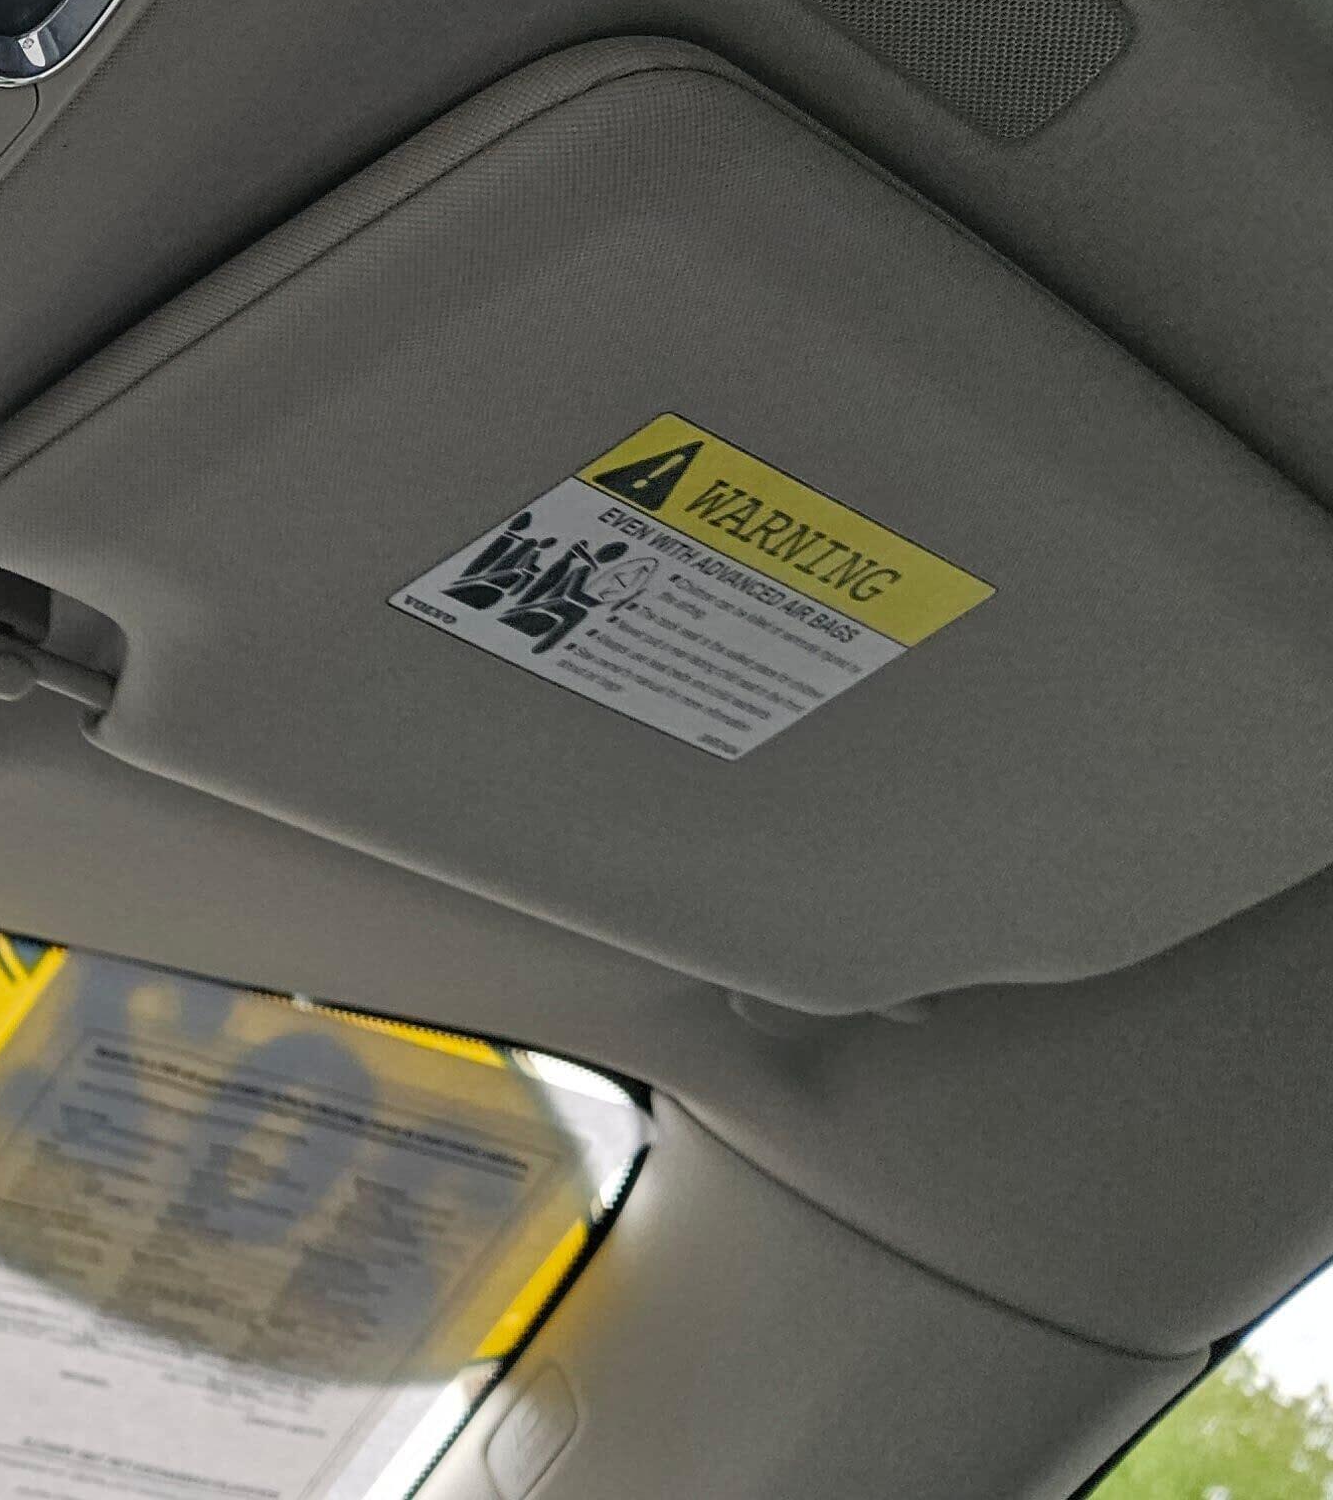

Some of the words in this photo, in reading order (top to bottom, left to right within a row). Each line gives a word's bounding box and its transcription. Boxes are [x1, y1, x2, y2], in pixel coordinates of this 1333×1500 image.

[598, 507, 654, 540] EVEN
[648, 531, 694, 563] WITH
[692, 556, 786, 607] ADVANCED
[780, 601, 813, 626] AIR
[807, 611, 861, 644] BAGS
[685, 478, 901, 602] WARNING
